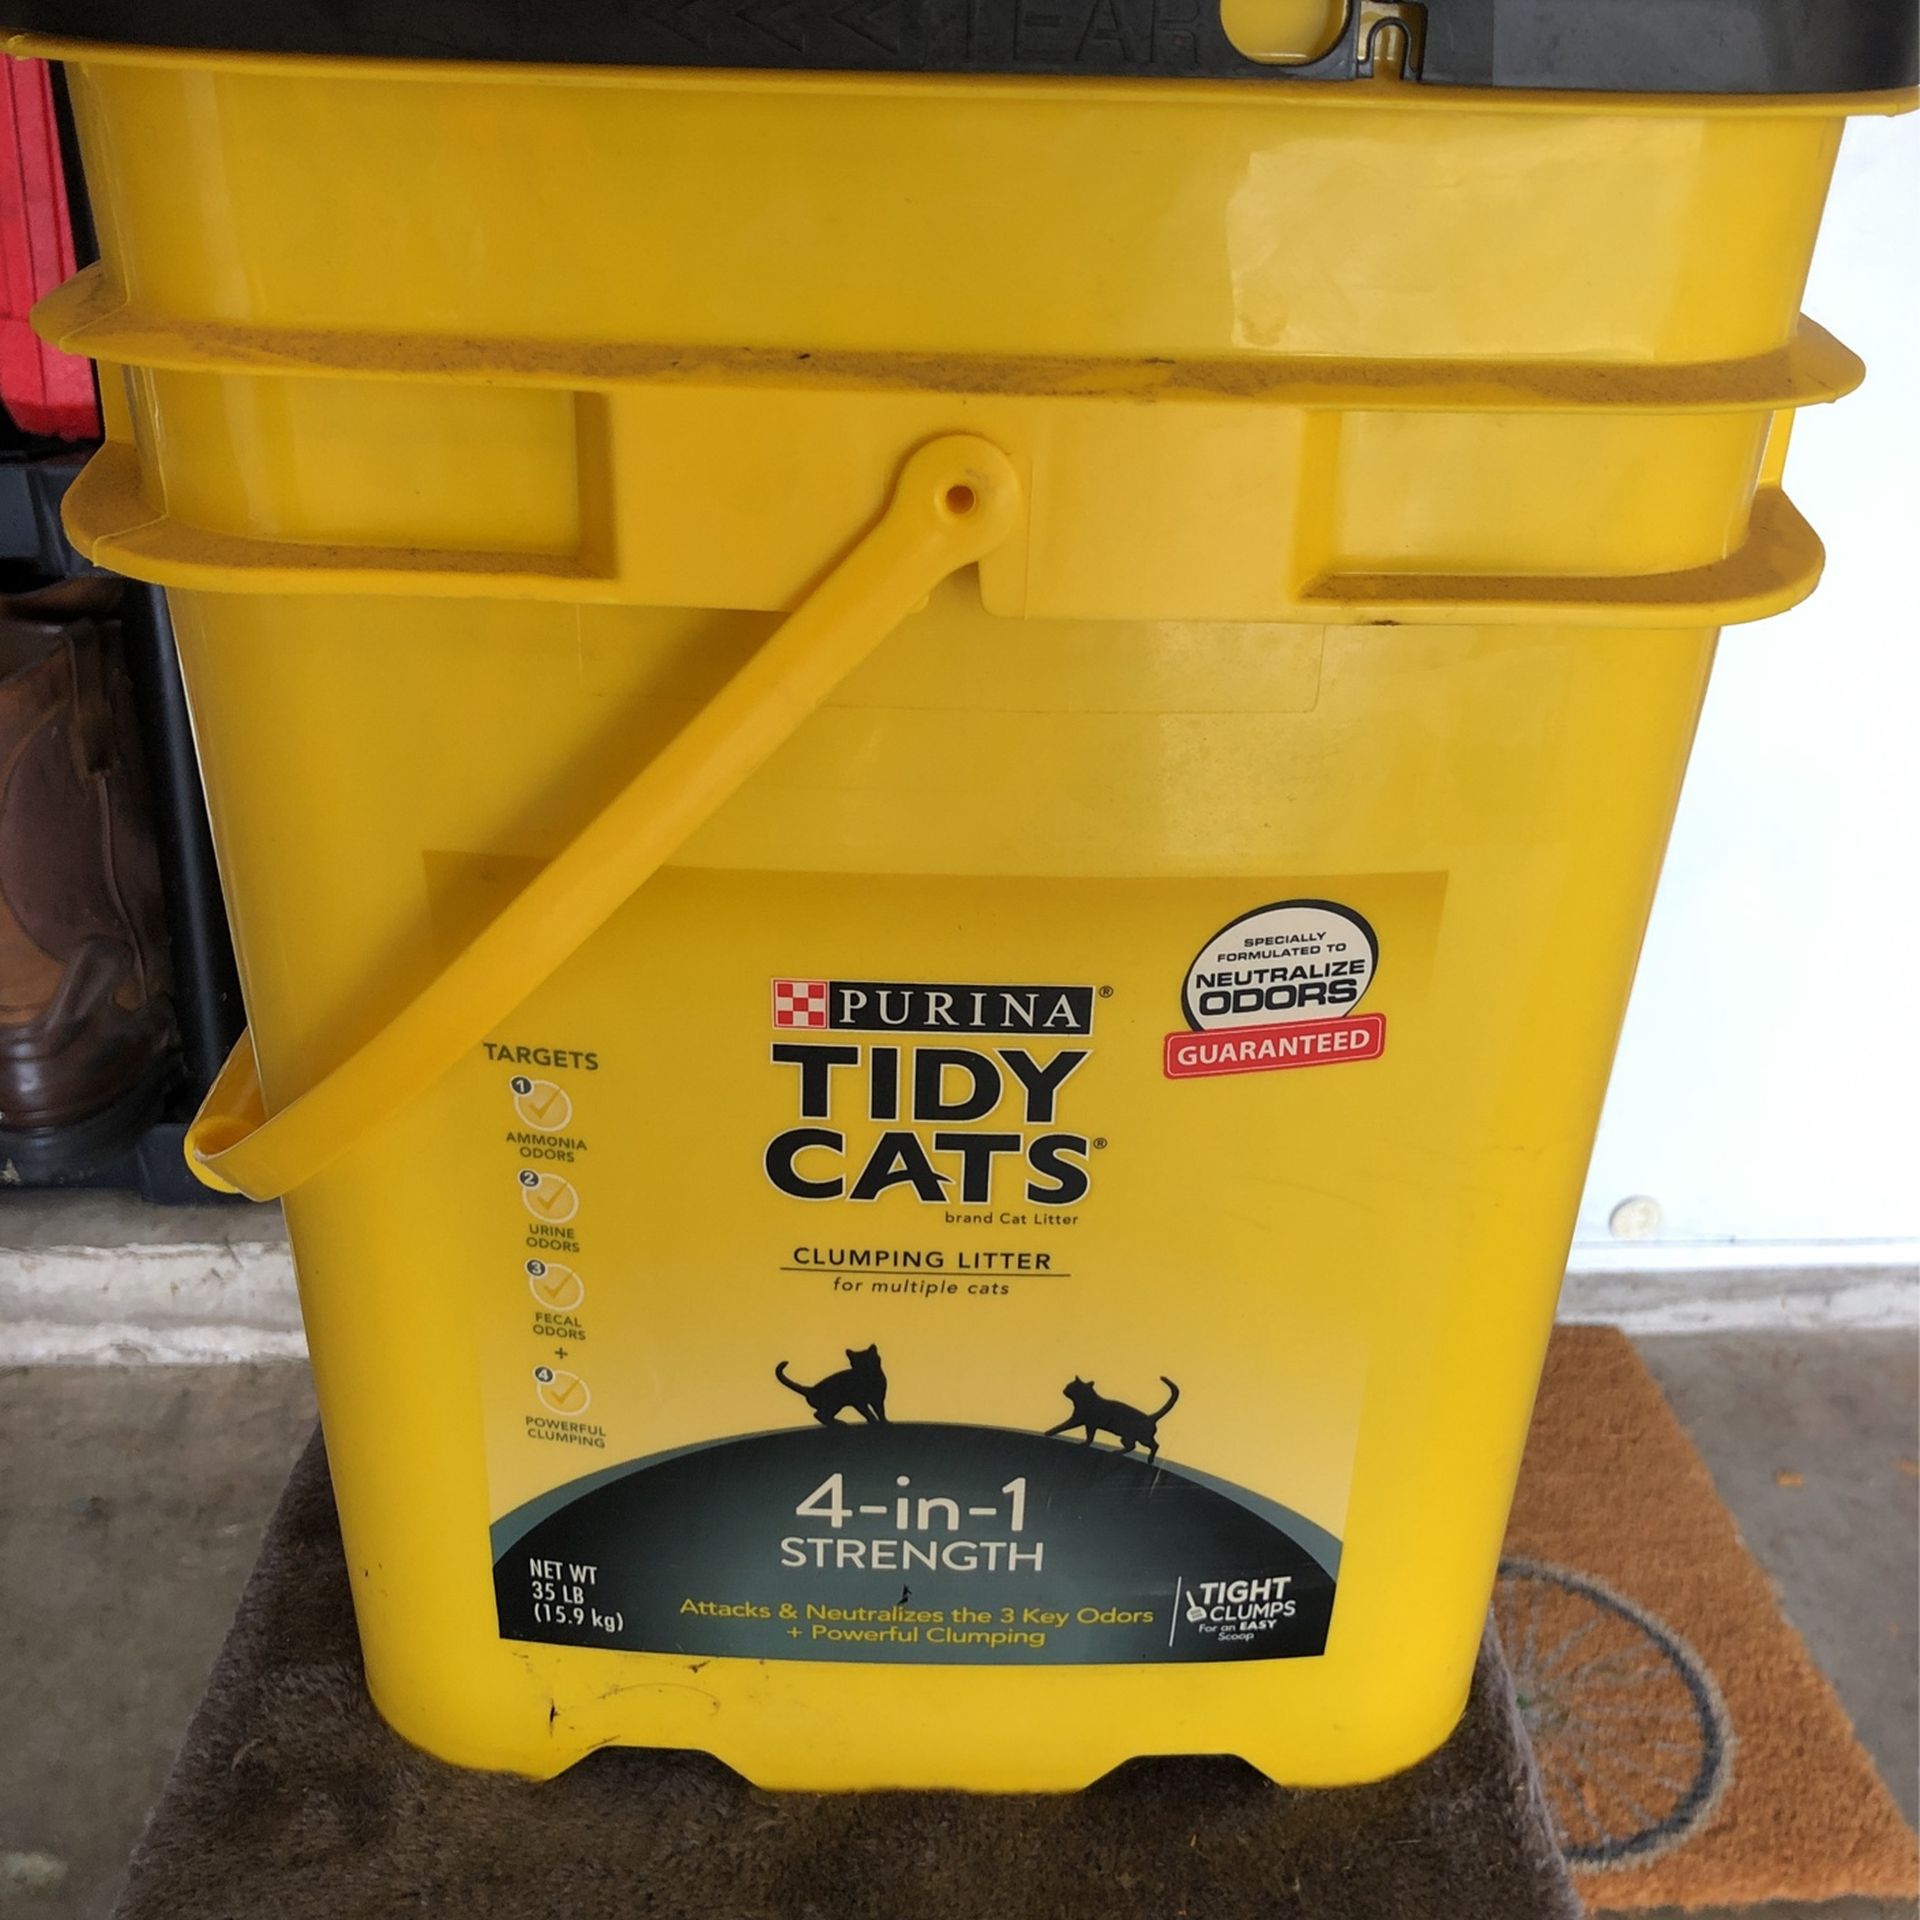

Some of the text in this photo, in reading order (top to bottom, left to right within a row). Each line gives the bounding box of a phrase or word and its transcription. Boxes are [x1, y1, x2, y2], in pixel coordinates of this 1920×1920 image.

[1244, 931, 1327, 948] SPECIALLY
[1217, 943, 1347, 963] FORMULATED TO
[1196, 959, 1366, 989] NEUTRALIZE
[1199, 978, 1358, 1016] ODORS
[483, 1042, 599, 1071] TARGETS
[1177, 1029, 1370, 1066] GUARANTEED
[516, 1079, 525, 1093] 1
[771, 1043, 1093, 1124] TIDY
[506, 1132, 588, 1151] AMMONIA
[519, 1147, 575, 1164] ODORS
[523, 1172, 535, 1186] 2
[945, 1211, 1079, 1225] brand Cat Litter
[529, 1223, 575, 1239] URINE
[526, 1237, 580, 1253] ODORS
[532, 1261, 542, 1274] 3
[793, 1247, 1051, 1270] CLUMPING LITTER
[833, 1277, 1010, 1297] for multiple cats
[535, 1311, 582, 1328] FECAL
[532, 1324, 586, 1341] ODORS
[538, 1369, 550, 1382] 4
[525, 1416, 606, 1437] POWERFUL
[527, 1428, 606, 1449] CLUMPING
[795, 1472, 1027, 1532] 4-in-1
[780, 1536, 1044, 1572] STRENGTH
[529, 1557, 598, 1585] NET WT
[531, 1580, 584, 1605] 35 LB
[1199, 1576, 1292, 1605] TIGHT
[534, 1602, 624, 1633] (15.9 kg)
[680, 1598, 1154, 1628] Attacks & Neutralizes the 3 Key Odors
[1209, 1600, 1297, 1622] CLUMPS
[812, 1624, 918, 1643] Powerful
[926, 1627, 1046, 1648] Clumping
[1199, 1619, 1277, 1633] For an EASY
[1218, 1631, 1255, 1642] Scoop
